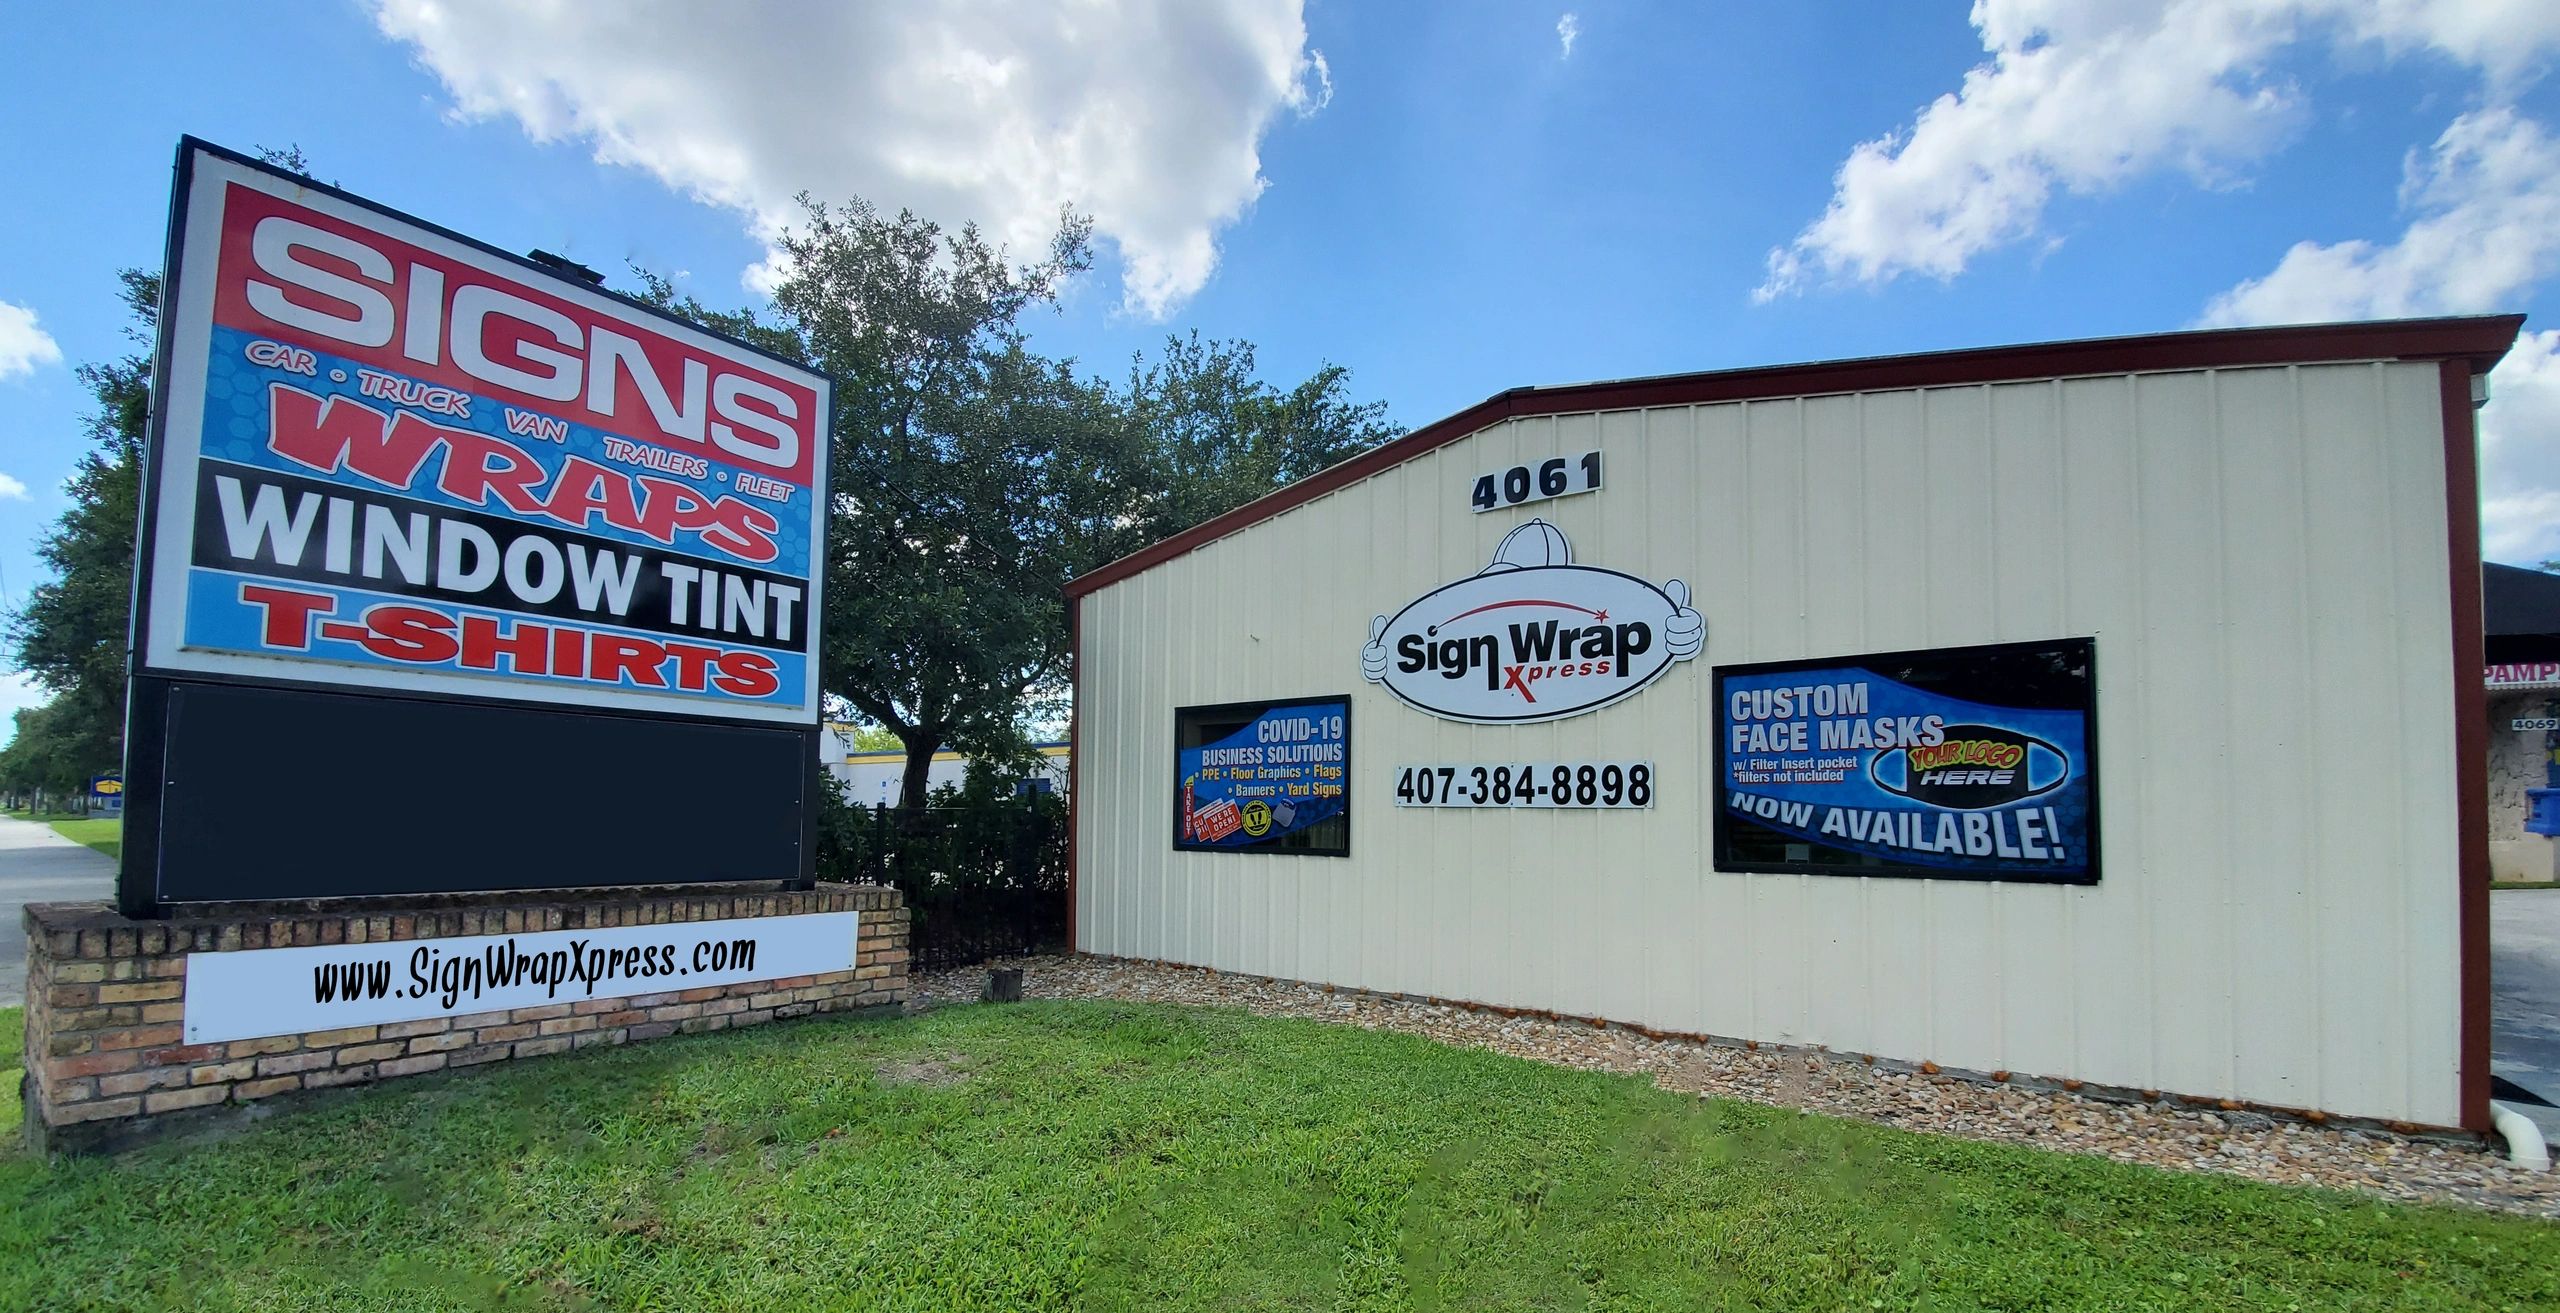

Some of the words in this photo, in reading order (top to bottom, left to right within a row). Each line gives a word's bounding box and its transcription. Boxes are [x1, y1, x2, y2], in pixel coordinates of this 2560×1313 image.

[245, 216, 800, 469] SIGNS
[245, 341, 317, 375] CAR
[357, 369, 471, 418] TRUCK
[504, 408, 568, 443] VAN
[603, 436, 708, 480] TRAILERS
[735, 473, 795, 502] FLEET
[267, 383, 779, 564] WRAPS
[1472, 451, 1600, 509] 4061
[215, 475, 642, 616] WINDOW
[661, 564, 801, 640] TINT
[241, 583, 781, 698] T-SHIRTS
[1397, 625, 1499, 691] Sign
[1509, 619, 1652, 677] Wrap
[1504, 660, 1610, 703] Xpress
[2484, 663, 2560, 683] PAMP
[1731, 682, 1868, 721] CUSTOM
[1258, 716, 1343, 743] COVID-19
[1732, 720, 1808, 754] FACE
[1820, 715, 1945, 751] MASKS
[2514, 720, 2556, 729] 4069
[1202, 747, 1263, 766] BUSINESS
[1267, 743, 1343, 763] SOLUTIONS
[1202, 768, 1220, 780] PPE
[1231, 767, 1254, 780] Floor
[1257, 765, 1301, 781] Graphics
[1313, 764, 1342, 780] Flags
[1733, 760, 1747, 771] w/
[1750, 758, 1778, 770] Filter
[1781, 757, 1814, 769] Insert
[1817, 756, 1858, 770] pocket
[1909, 741, 1962, 772] YOUR
[1964, 740, 2024, 768] LOGO
[1236, 784, 1275, 796] Banners
[1287, 782, 1309, 796] Yard
[1312, 782, 1342, 798] Signs
[1397, 765, 1651, 807] 407-384-8898
[1773, 771, 1792, 782] not
[1794, 769, 1844, 782] included
[1920, 769, 2016, 786] HERE
[1731, 792, 1815, 828] NOW
[1821, 806, 2065, 860] AVAILABLE!
[314, 939, 756, 1009] www.SignWrapXpress.com
